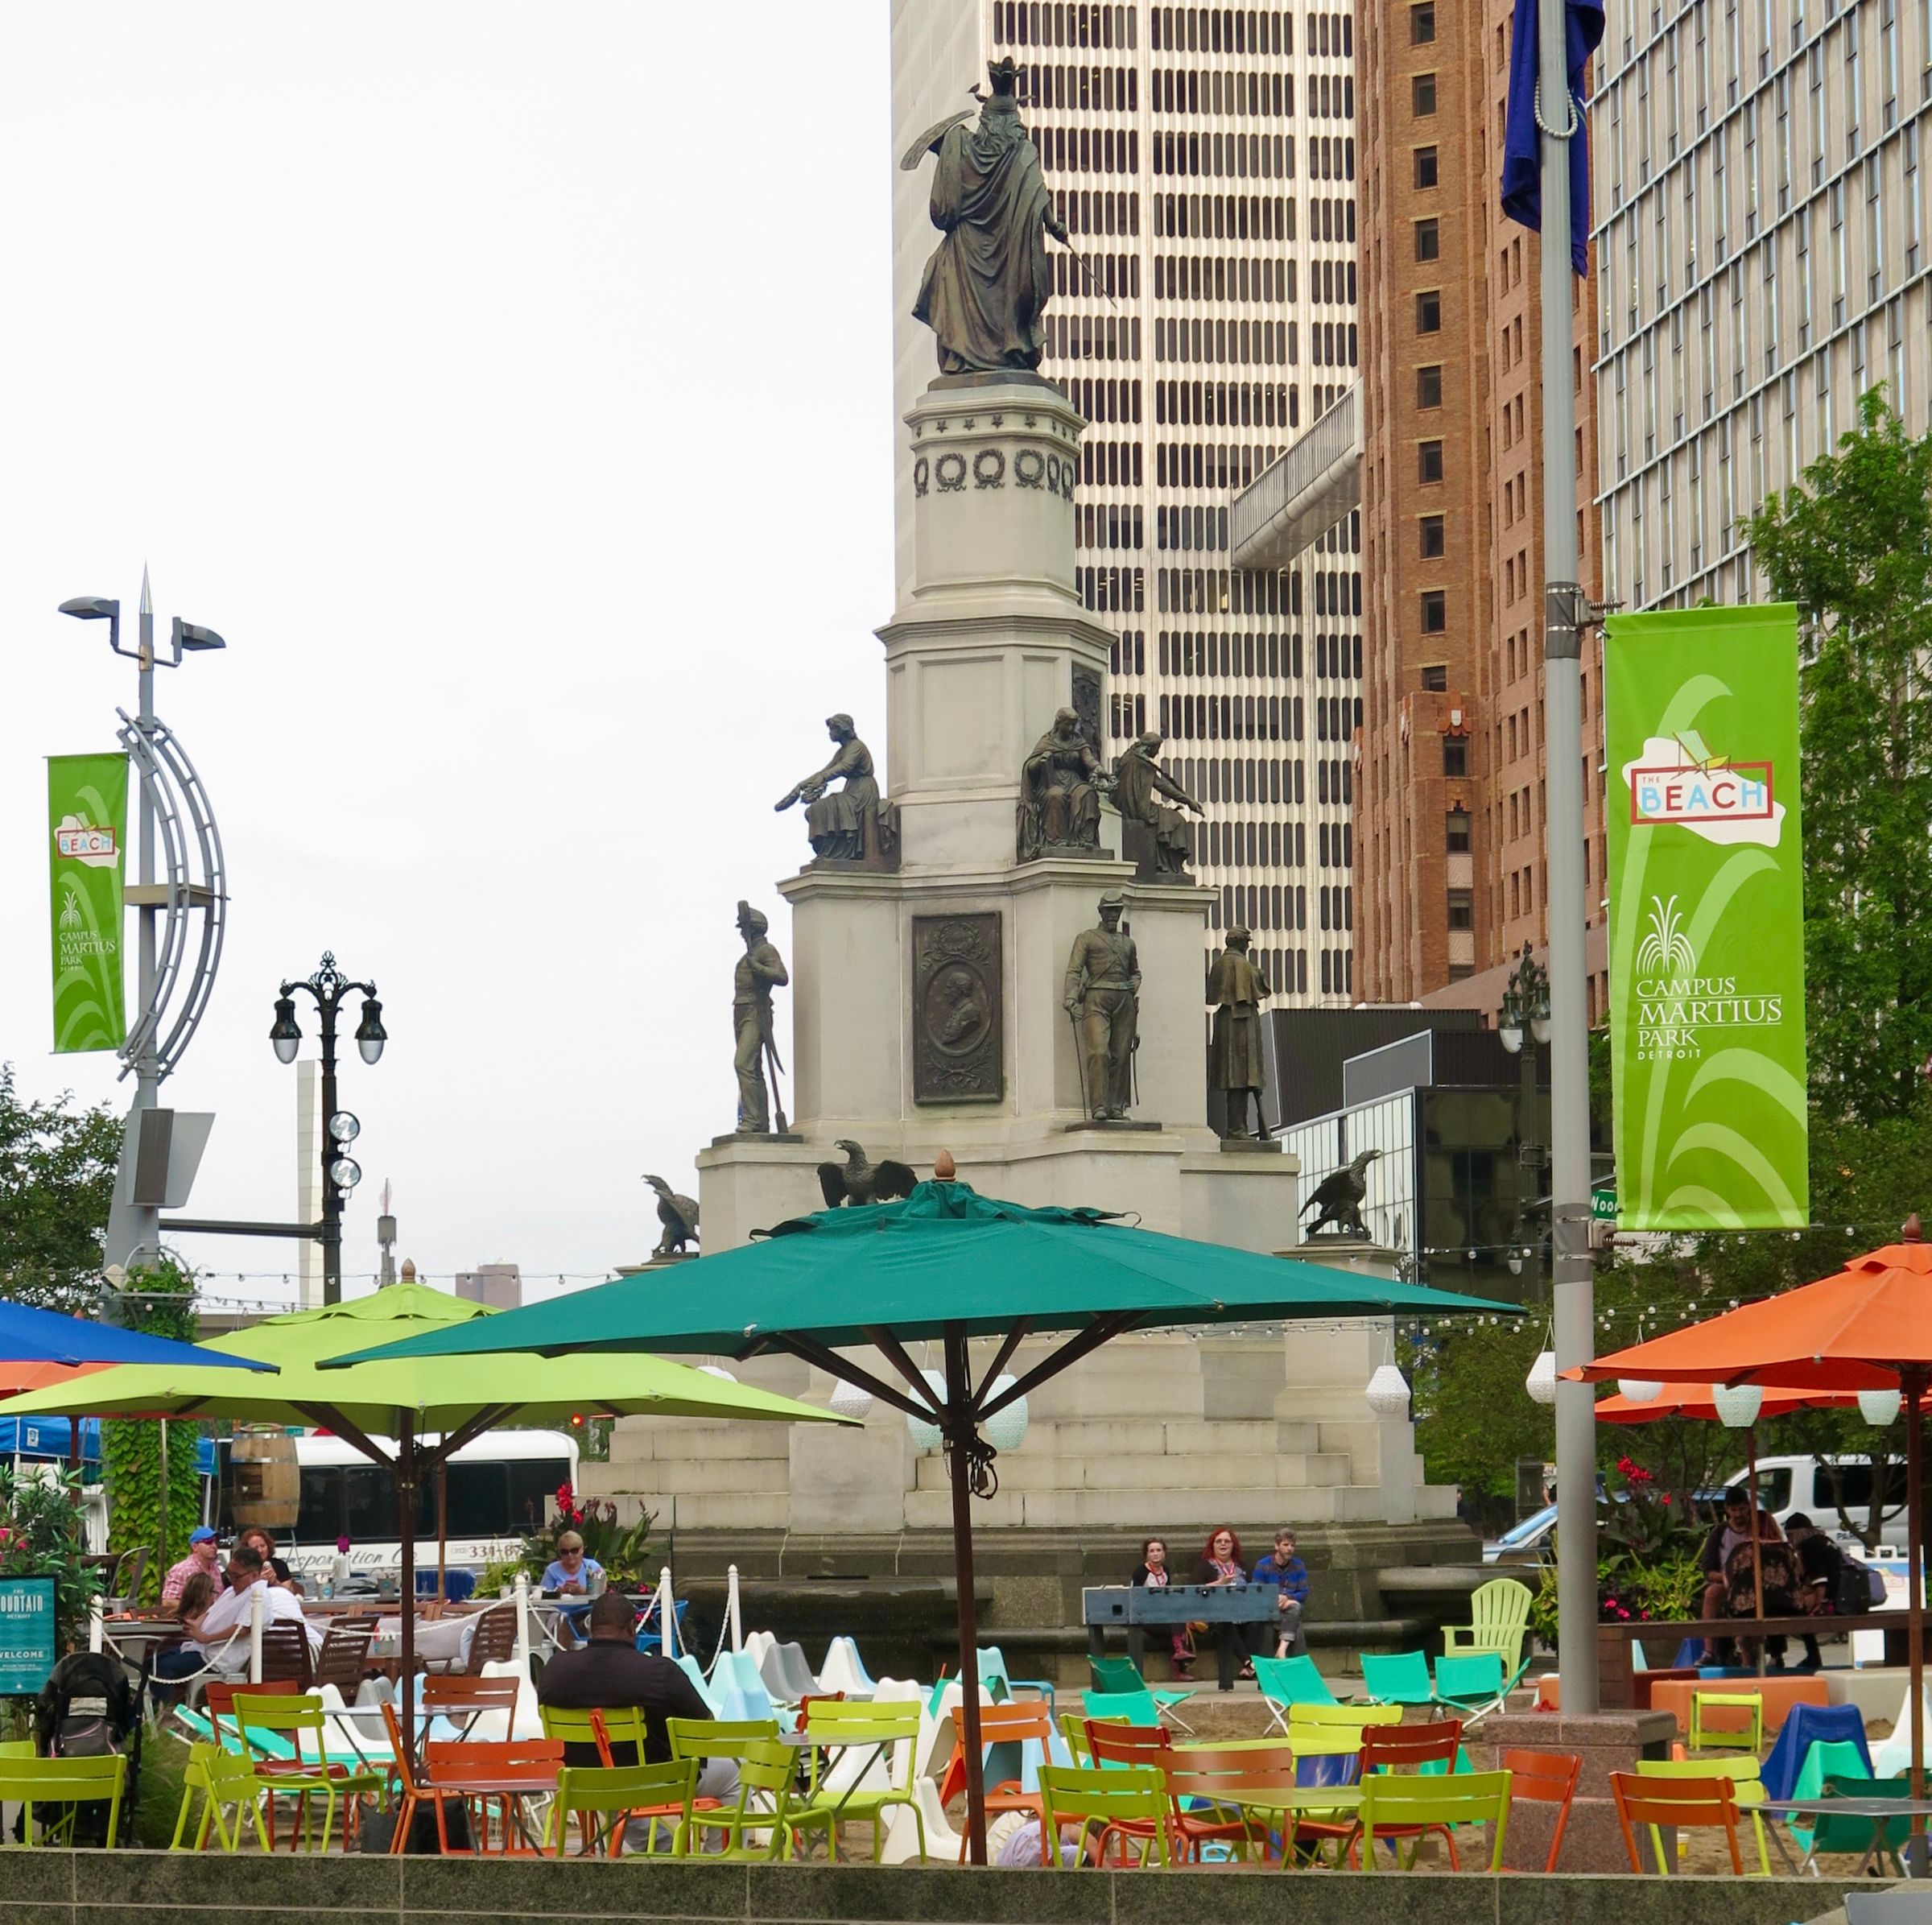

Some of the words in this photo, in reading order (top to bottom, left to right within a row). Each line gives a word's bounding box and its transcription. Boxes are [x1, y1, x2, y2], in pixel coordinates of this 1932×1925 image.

[1642, 775, 1661, 783] THE
[1641, 781, 1763, 812] BEACH
[60, 837, 111, 852] BEACH
[60, 930, 97, 942] CAMPUS
[60, 940, 116, 956] MARTIUS
[60, 956, 83, 966] PARK
[1636, 976, 1736, 998] CAMPUS
[1637, 997, 1782, 1026] MARTIUS
[1637, 1028, 1699, 1047] PARK
[1637, 1048, 1701, 1060] DETROIT
[0, 1595, 43, 1613] OUNTAIN
